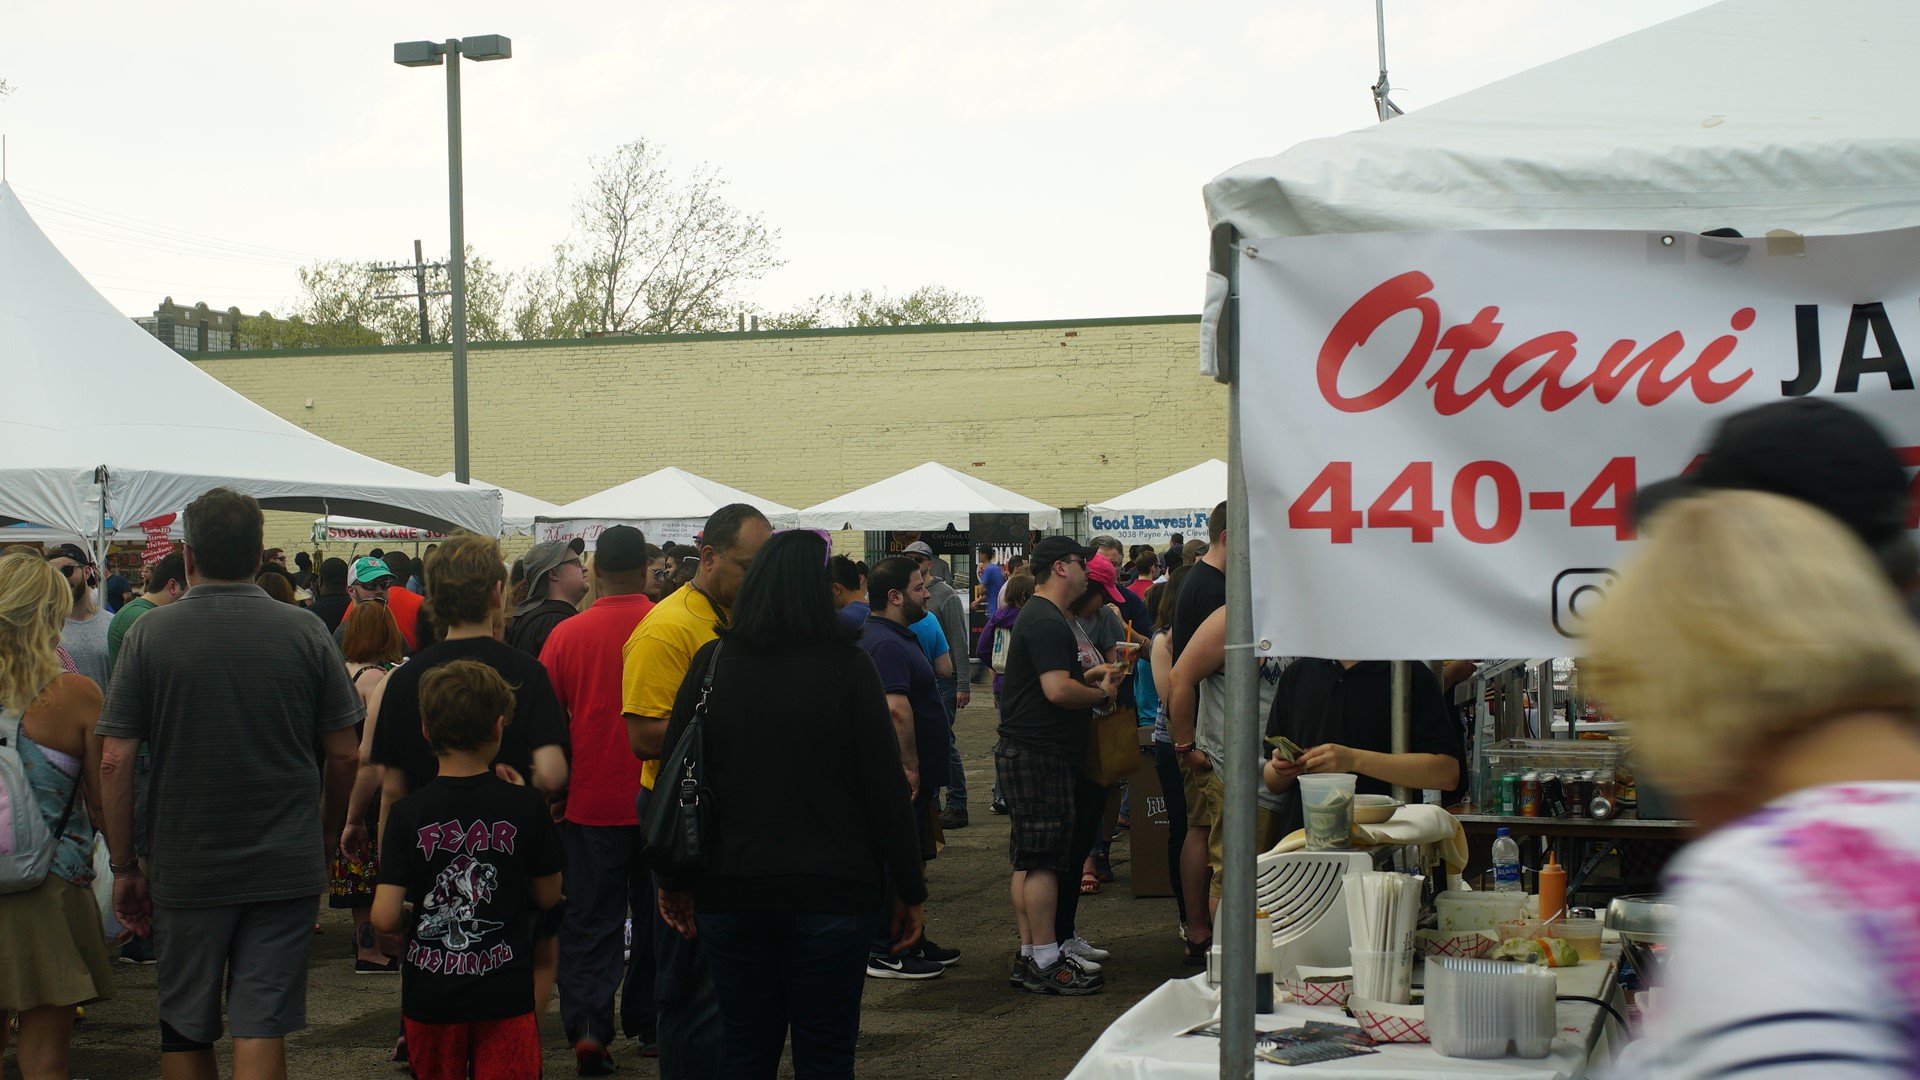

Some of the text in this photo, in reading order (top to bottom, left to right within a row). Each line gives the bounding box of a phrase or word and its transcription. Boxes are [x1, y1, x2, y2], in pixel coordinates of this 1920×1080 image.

[1315, 269, 1757, 417] Otani
[1287, 453, 1645, 544] 440-4
[1092, 515, 1129, 530] Good
[1132, 514, 1193, 530] Harvest
[328, 526, 449, 540] SUGAR CANE JU
[932, 532, 964, 540] Cleveland,
[1138, 531, 1161, 540] Payne
[975, 546, 1023, 565] IDIAN
[416, 818, 518, 862] FEAR
[406, 936, 514, 977] THE PIRATE
